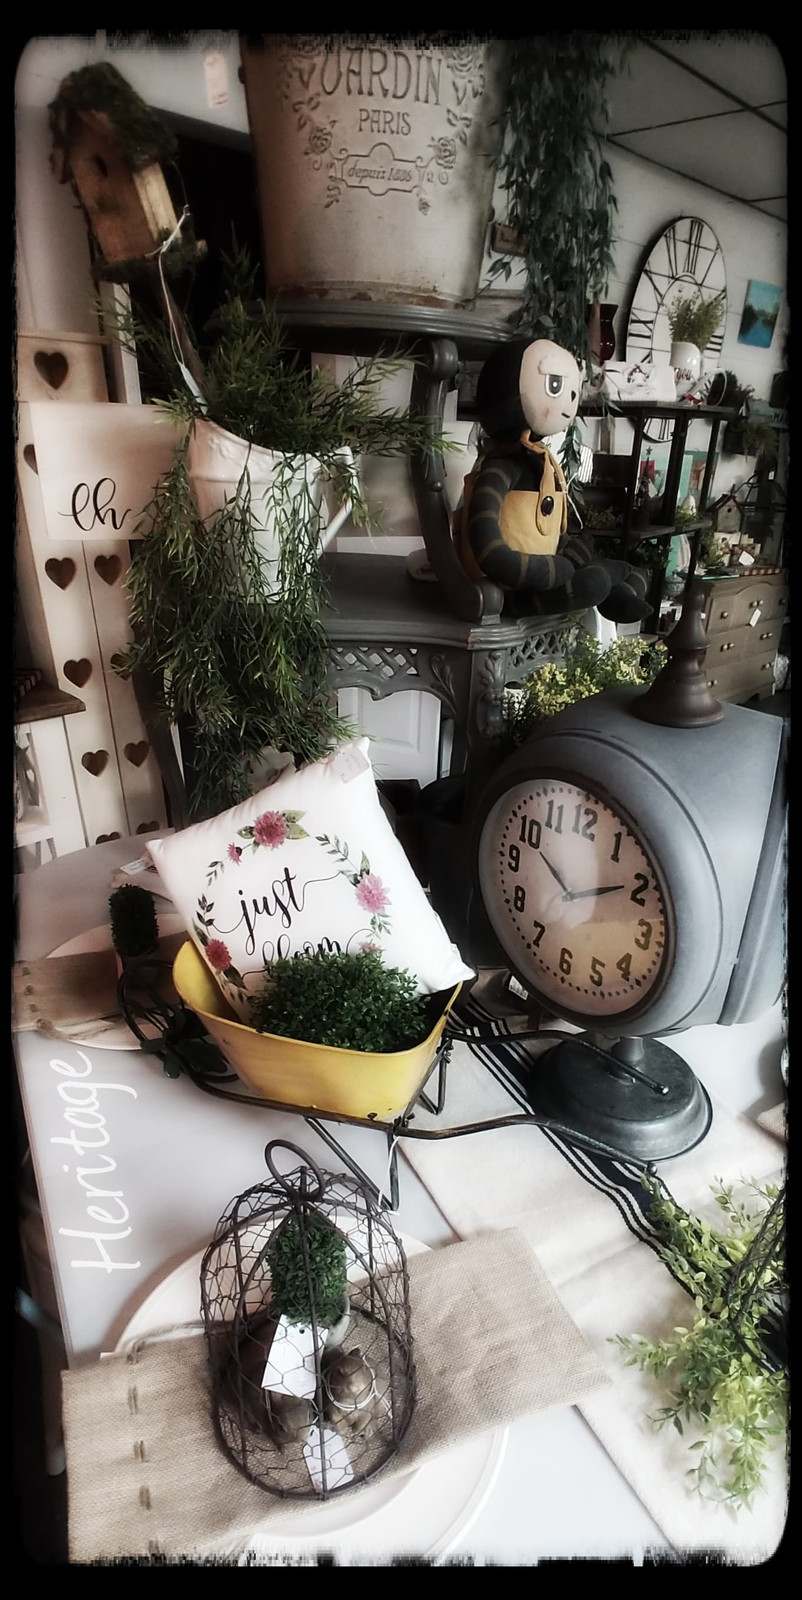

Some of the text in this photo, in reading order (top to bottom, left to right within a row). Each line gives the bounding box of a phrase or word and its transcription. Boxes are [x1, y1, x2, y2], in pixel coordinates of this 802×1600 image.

[358, 108, 412, 136] PARIS
[347, 159, 386, 183] depuis
[518, 814, 542, 850] 10
[545, 799, 564, 834] 11
[571, 803, 599, 842] 12
[507, 844, 521, 873] 9
[610, 831, 622, 863] 1
[513, 885, 526, 913] 8
[630, 872, 650, 907] 2
[224, 867, 312, 955] just
[533, 920, 546, 948] 7
[634, 918, 653, 951] 3
[558, 947, 573, 976] 6
[589, 956, 606, 987] 5
[616, 952, 632, 982] 4
